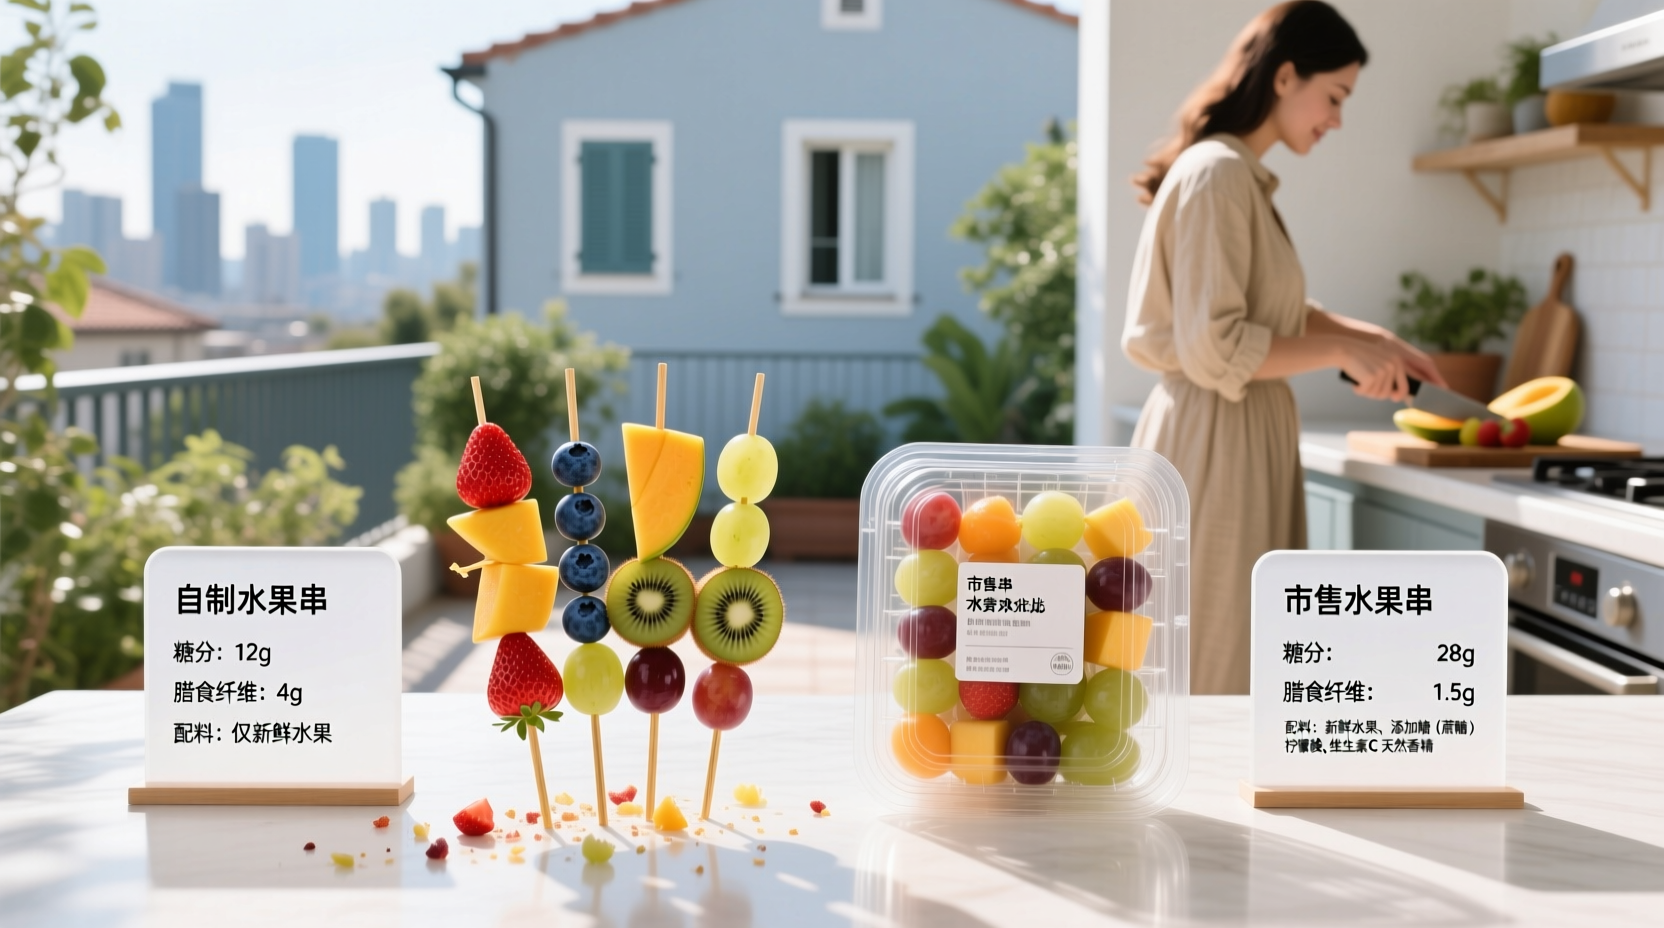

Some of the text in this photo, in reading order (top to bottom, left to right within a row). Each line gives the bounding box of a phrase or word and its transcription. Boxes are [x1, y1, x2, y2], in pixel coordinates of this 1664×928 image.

[177, 583, 327, 616] 自制水果串
[1284, 583, 1433, 616] 市售水果串
[1436, 643, 1475, 668] 28g
[1433, 682, 1475, 707] 1.5g
